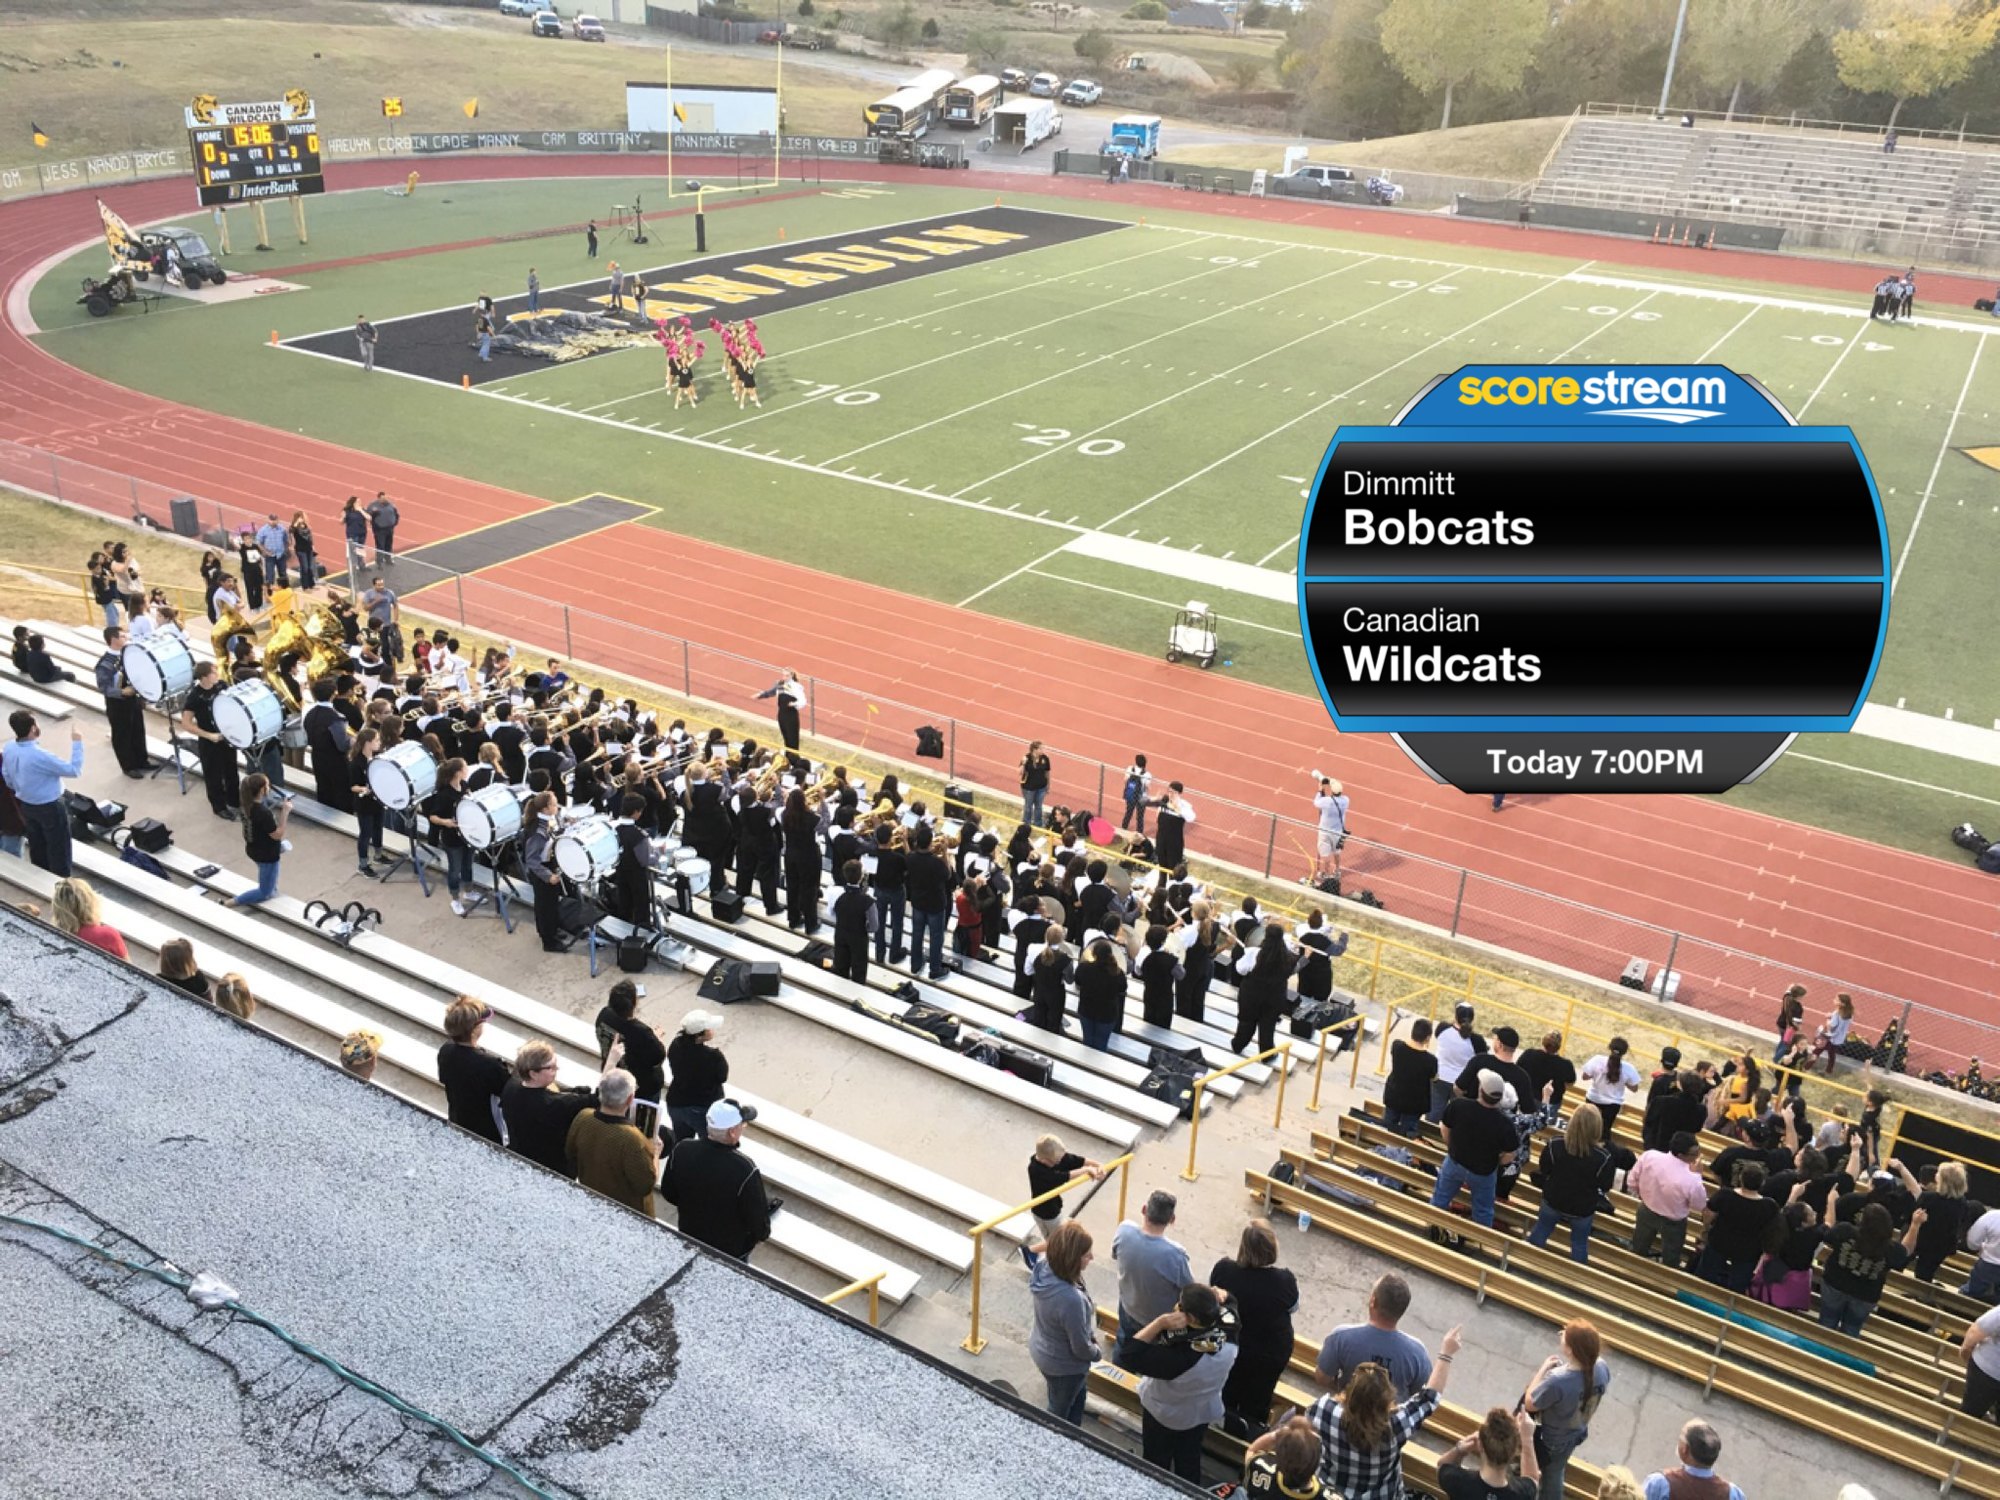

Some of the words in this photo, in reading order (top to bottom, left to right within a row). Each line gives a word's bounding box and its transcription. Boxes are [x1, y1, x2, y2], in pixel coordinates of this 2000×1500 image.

[226, 104, 281, 115] CANADIAN
[385, 98, 402, 117] 25
[227, 113, 282, 124] WILDCATS
[196, 131, 222, 142] HOME
[287, 124, 316, 135] VISITOR
[308, 134, 318, 153] 0
[432, 135, 470, 149] CADE
[477, 134, 519, 147] MANNY
[542, 133, 566, 146] CAM
[577, 132, 642, 145] BRITTANY
[204, 143, 215, 162] 0
[43, 162, 79, 182] JESS
[135, 150, 176, 168] BRYCE
[243, 180, 299, 197] InterBank
[506, 224, 1030, 325] ANADIAN
[800, 383, 881, 406] 10
[1021, 428, 1126, 456] 20
